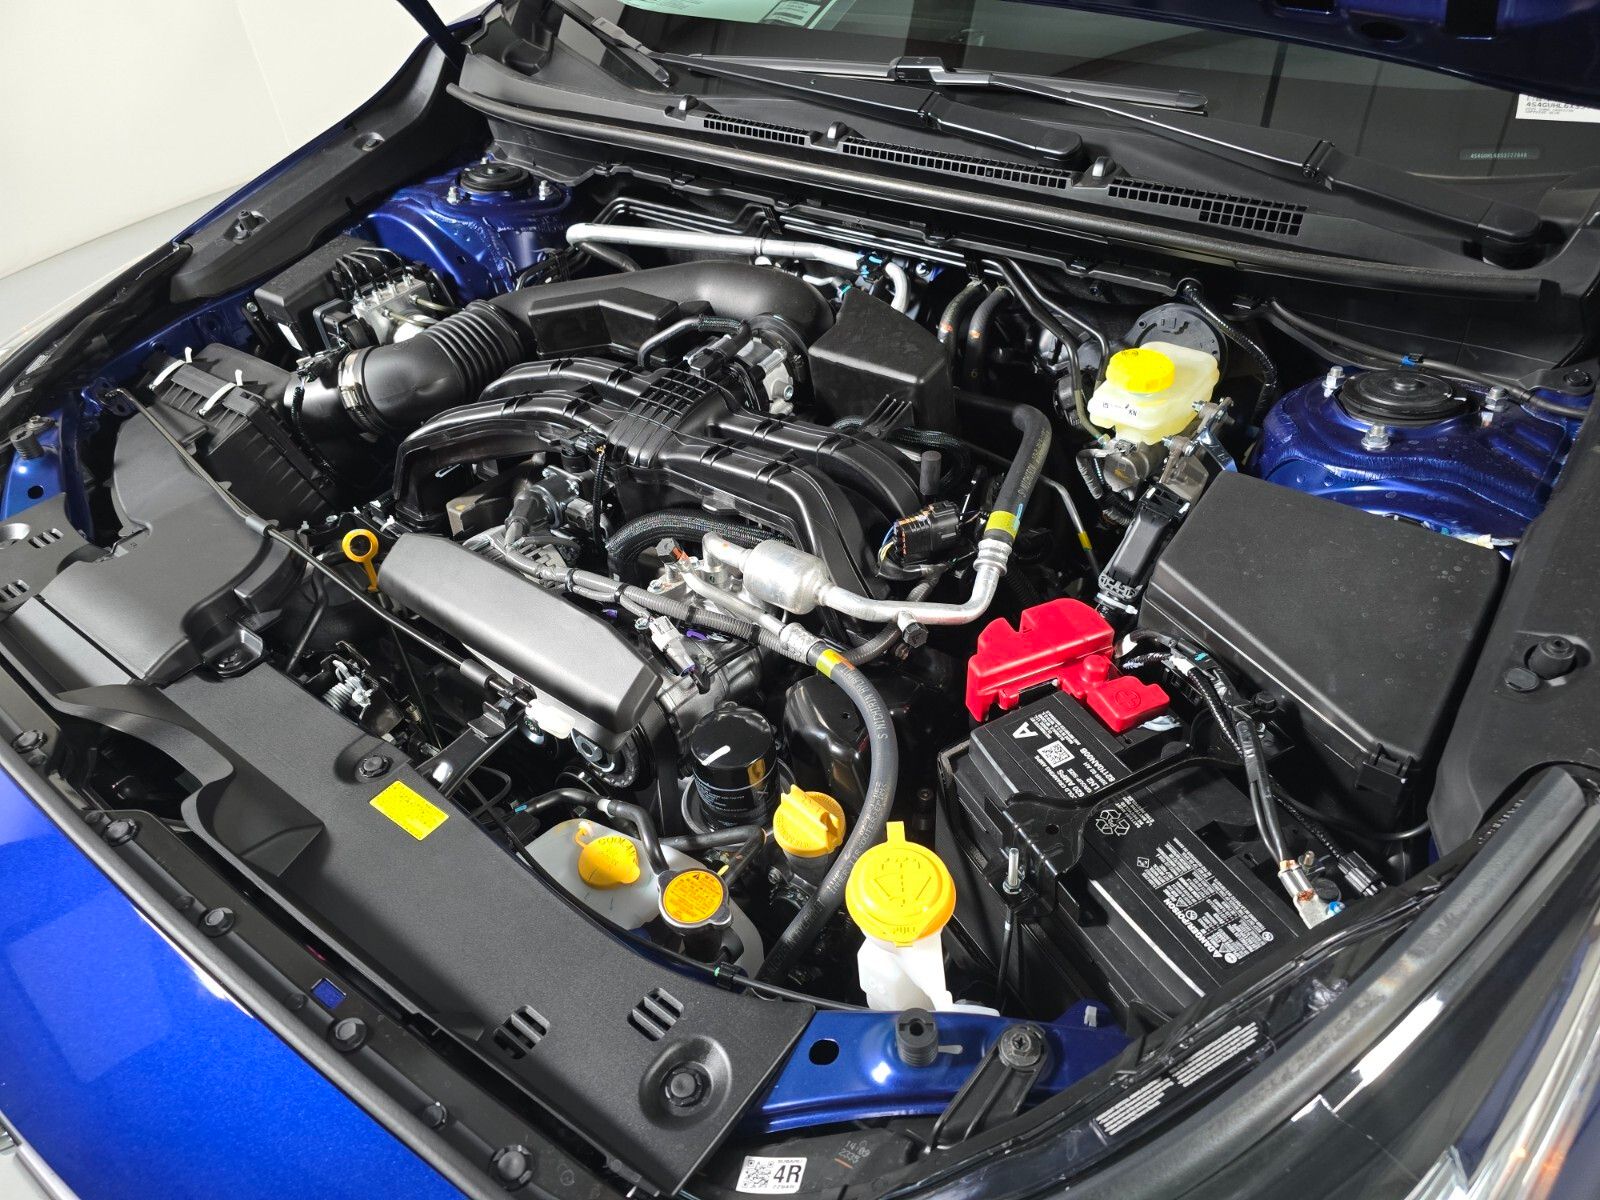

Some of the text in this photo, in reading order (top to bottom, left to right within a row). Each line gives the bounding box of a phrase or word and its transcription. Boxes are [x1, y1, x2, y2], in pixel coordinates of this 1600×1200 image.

[1012, 721, 1038, 740] A
[1056, 769, 1084, 798] 620 AMPS
[1086, 776, 1100, 790] LN2
[1064, 788, 1078, 798] OLD
[773, 1164, 802, 1183] 4R
